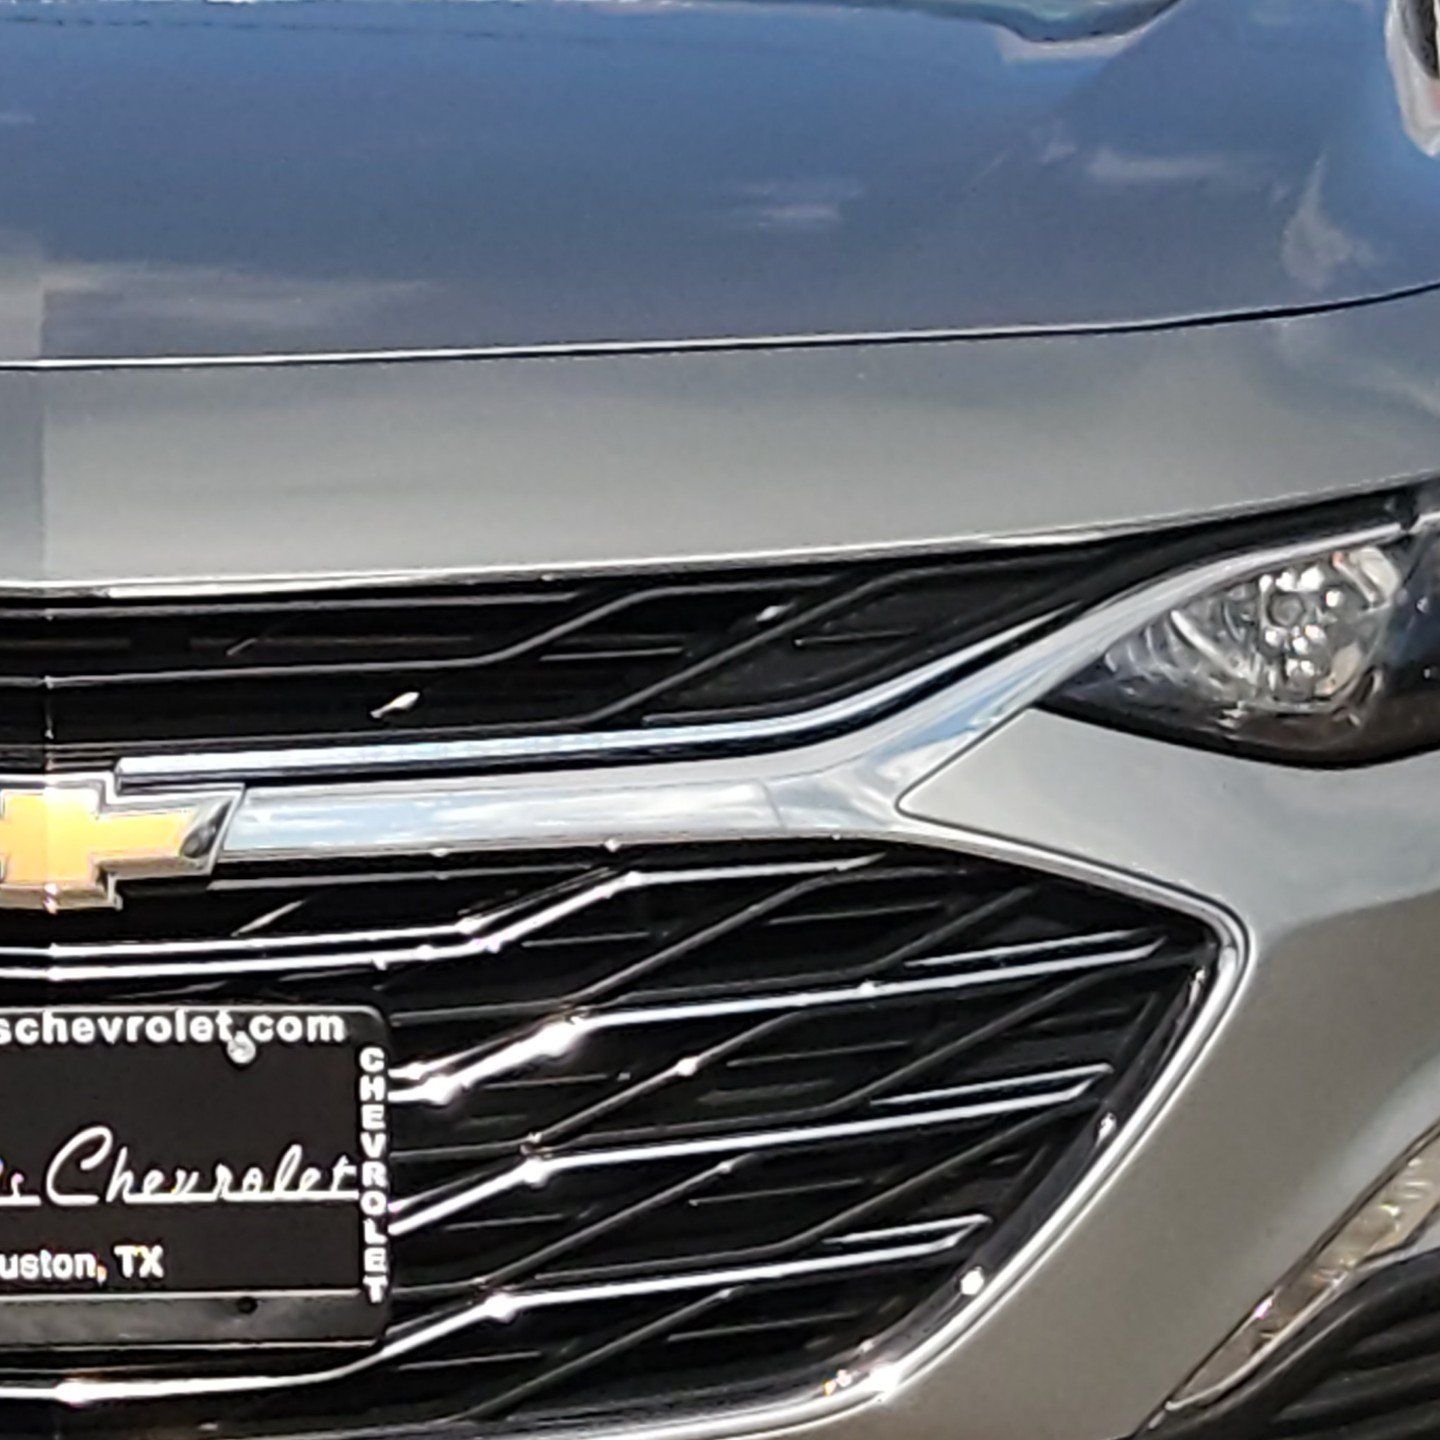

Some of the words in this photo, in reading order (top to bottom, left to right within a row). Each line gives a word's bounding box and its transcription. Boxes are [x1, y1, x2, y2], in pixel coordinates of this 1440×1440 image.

[45, 1126, 360, 1207] Chevrolet
[358, 1046, 388, 1303] CHEVROLET
[113, 1244, 165, 1279] TX
